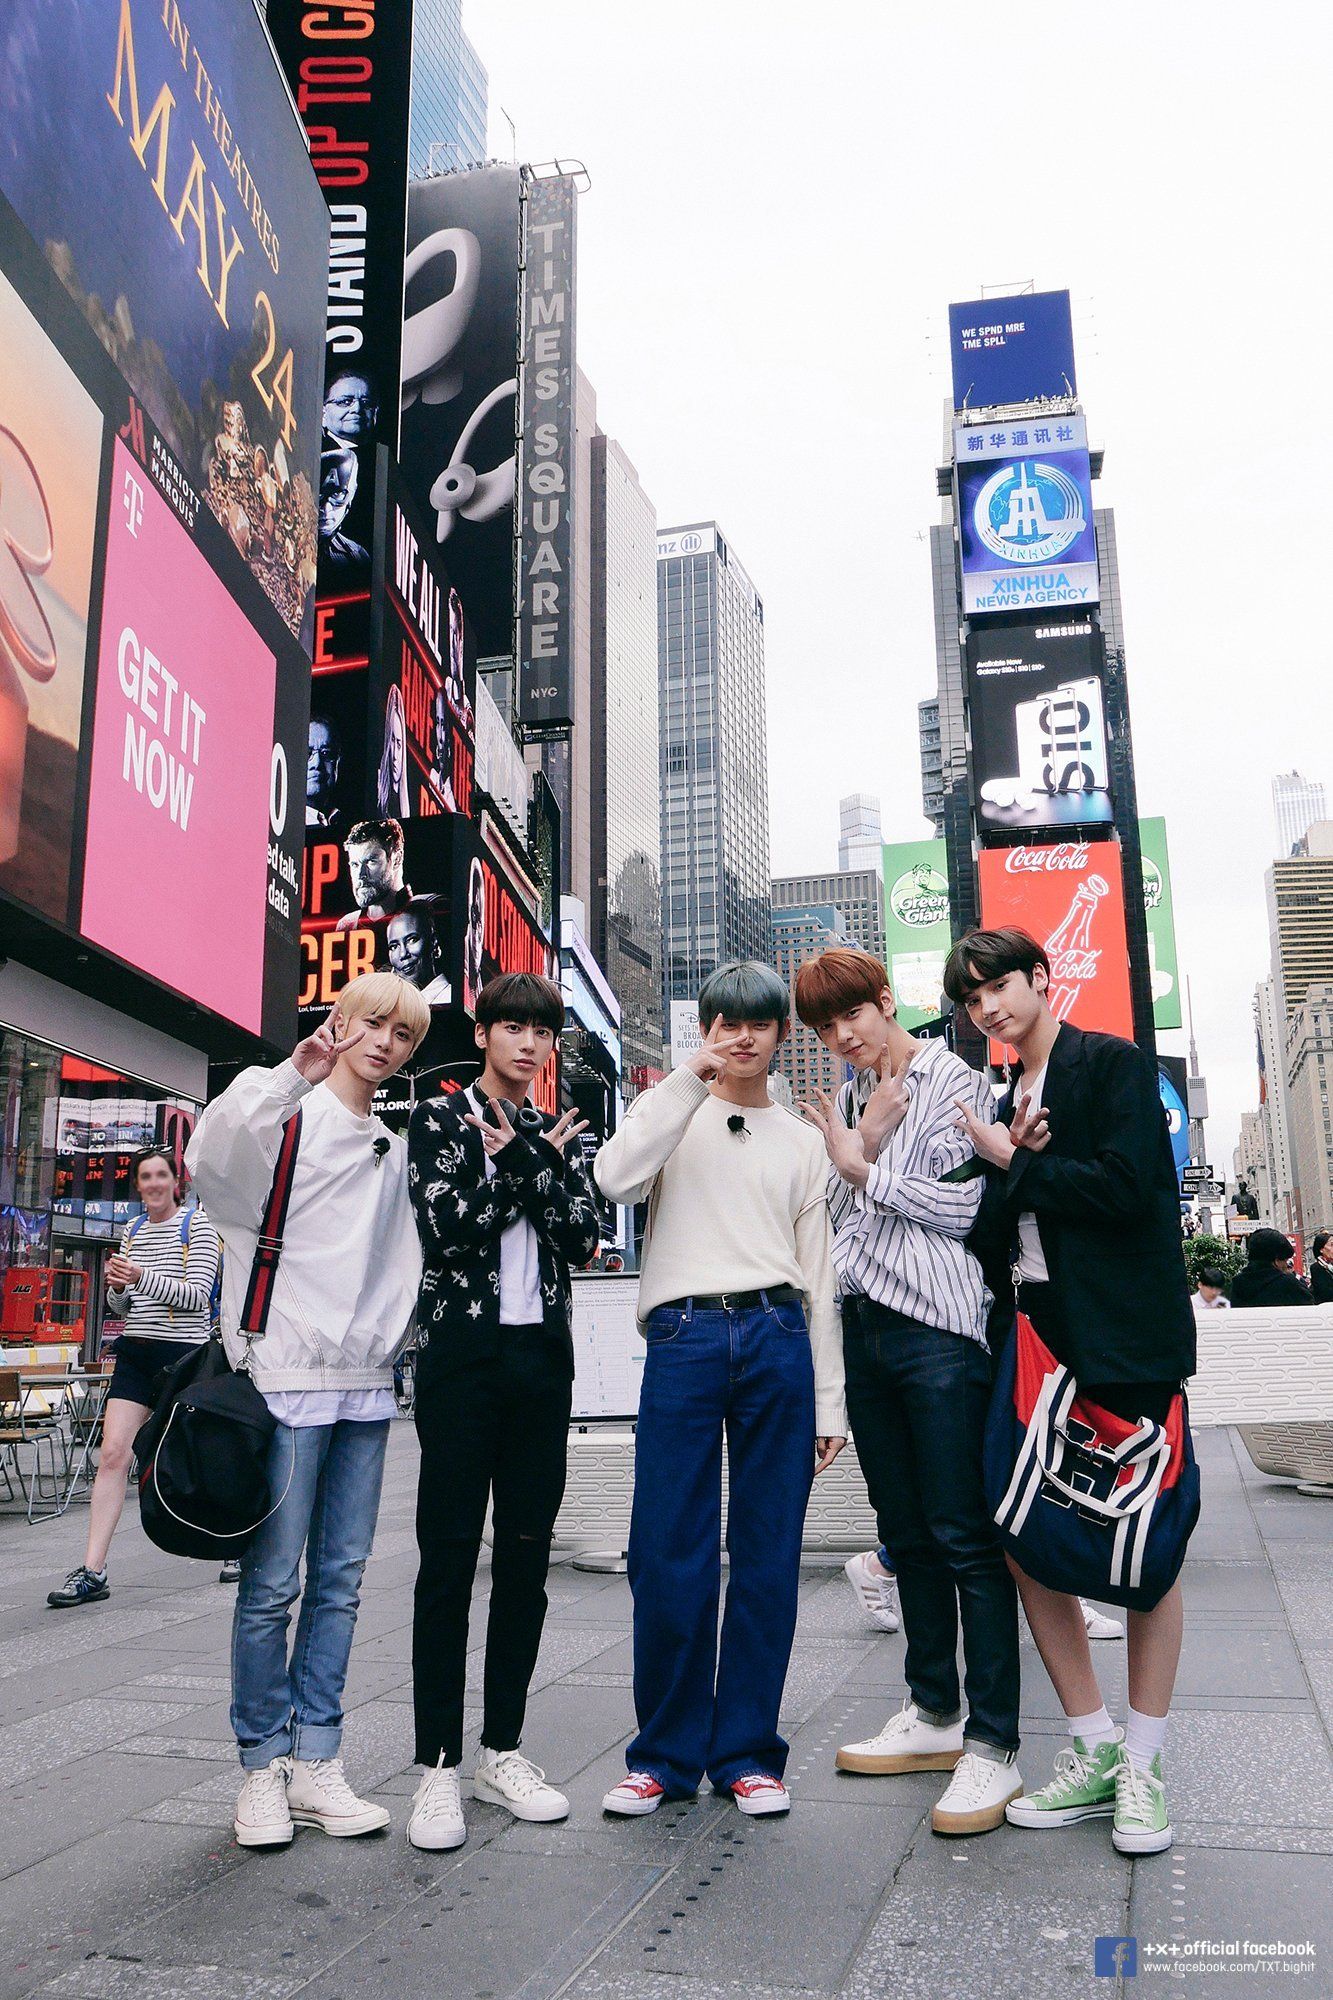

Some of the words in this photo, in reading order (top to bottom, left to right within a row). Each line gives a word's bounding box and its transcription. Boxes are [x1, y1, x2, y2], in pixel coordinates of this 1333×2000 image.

[298, 56, 373, 112] TO
[193, 45, 281, 275] THEATRES
[306, 126, 369, 187] UP
[106, 0, 245, 330] MAY
[251, 290, 297, 452] 24
[326, 204, 367, 353] STAND
[531, 221, 565, 401] TIMES
[962, 327, 976, 338] WE
[979, 325, 1003, 337] SPND
[1005, 322, 1025, 333] MRE
[962, 338, 981, 350] TME
[984, 336, 1006, 347] SPLL
[967, 425, 1074, 451] 新华通讯社
[152, 434, 201, 514] MARRIOTT
[151, 457, 195, 529] MARQUIS
[528, 423, 566, 659] SQUARE
[998, 538, 1064, 561] XINHUA
[395, 502, 419, 619] WE
[419, 558, 442, 666] ALL
[976, 593, 1020, 609] NEWS
[1024, 587, 1089, 606] AGENCY
[992, 572, 1071, 594] XINHUA
[1035, 625, 1092, 639] SAMSUNG
[976, 660, 1006, 669] Available
[1006, 658, 1022, 666] Now
[976, 668, 1001, 676] Galaxy
[117, 626, 179, 737] GET
[181, 691, 207, 767] IT
[401, 638, 435, 764] HAVE
[530, 686, 558, 699] NYC
[122, 712, 195, 832] NOW
[1005, 842, 1092, 874] Coca-Cola
[268, 878, 290, 920] data
[900, 895, 948, 911] Green
[904, 905, 950, 923] Giant
[12, 1285, 33, 1294] JLG
